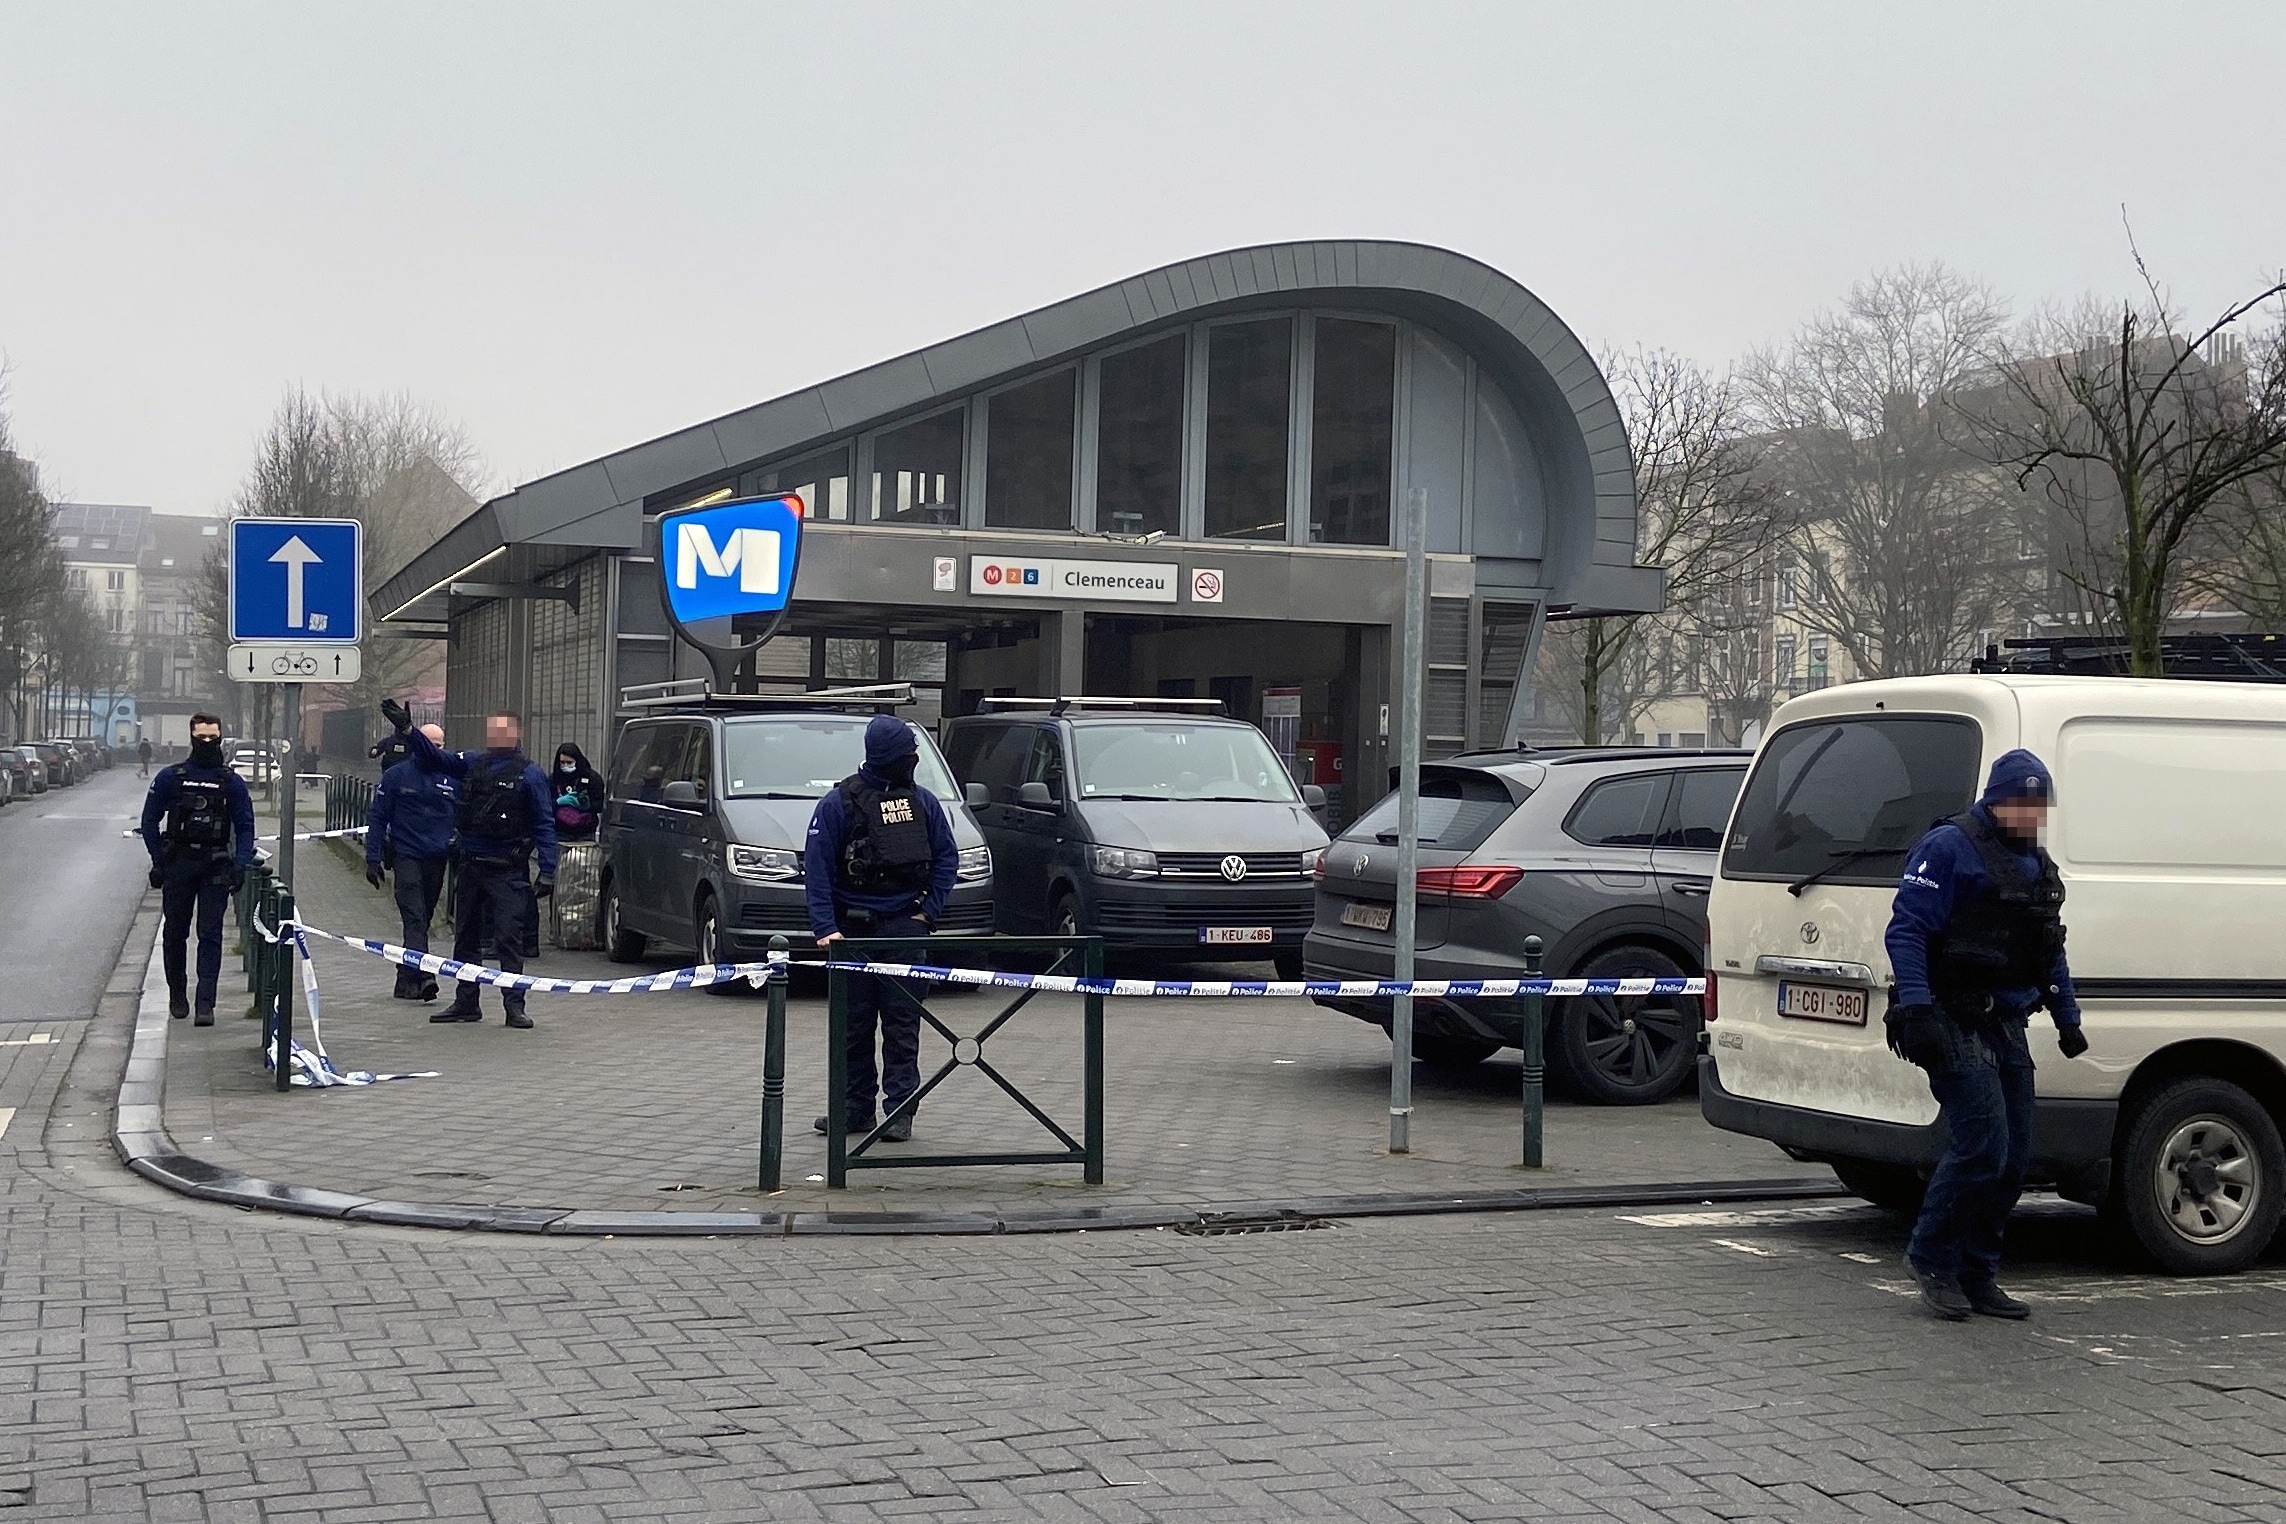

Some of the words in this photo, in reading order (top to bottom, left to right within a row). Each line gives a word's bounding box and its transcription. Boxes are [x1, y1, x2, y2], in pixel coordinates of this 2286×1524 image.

[677, 523, 781, 595] M
[986, 570, 999, 581] M
[1010, 571, 1017, 581] 2
[1027, 571, 1035, 582] 6
[1065, 571, 1165, 590] Clemenceau
[880, 799, 910, 813] POLICE
[882, 810, 913, 825] POLITIE
[1208, 929, 1271, 941] 1-KEU-486
[920, 971, 946, 980] Police
[1003, 978, 1029, 988] Police
[1086, 984, 1111, 995] Police
[1125, 986, 1151, 995] Politie
[1164, 986, 1188, 995] Police
[1201, 986, 1227, 995] Politie
[1239, 986, 1263, 995] Police
[1313, 986, 1337, 995] Police
[1349, 986, 1373, 995] Politie
[1386, 986, 1408, 995] Police
[1421, 986, 1445, 994] Politie
[1457, 986, 1479, 994] Police
[1491, 986, 1515, 994] Politie
[1526, 985, 1548, 994] Police
[1559, 985, 1583, 993] Politie
[1594, 984, 1616, 993] Police
[1627, 984, 1651, 992] Politie
[1662, 983, 1683, 992] Police
[1693, 983, 1705, 991] Pol
[1788, 989, 1862, 1018] 1-CGI-980
